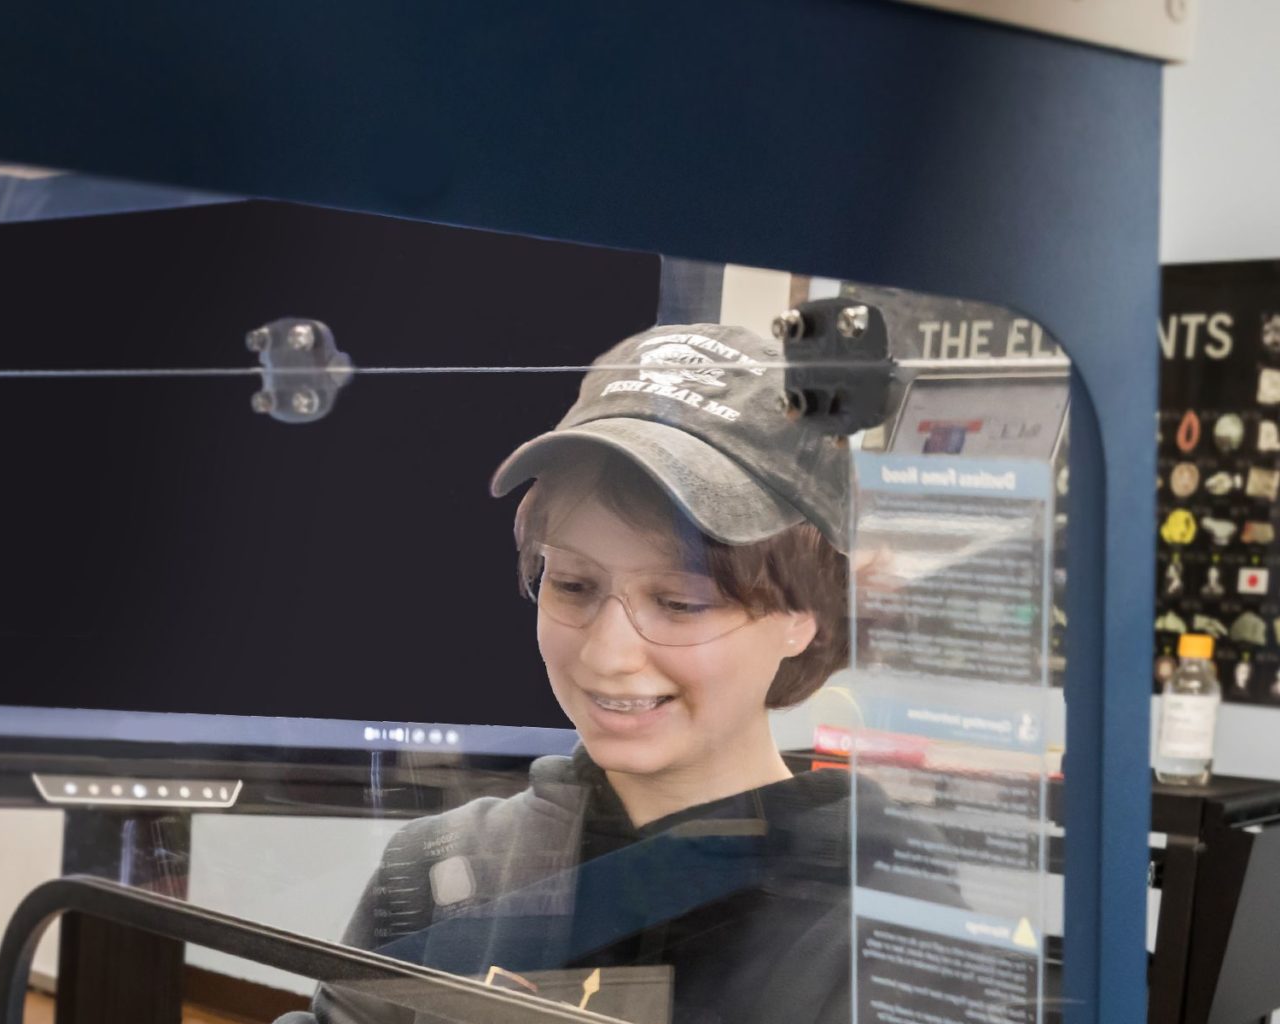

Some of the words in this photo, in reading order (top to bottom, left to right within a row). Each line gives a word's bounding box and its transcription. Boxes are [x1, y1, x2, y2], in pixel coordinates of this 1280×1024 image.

[686, 333, 741, 361] WANT
[919, 319, 993, 359] THE
[600, 380, 649, 397] FISH
[641, 382, 705, 408] FEAR
[702, 400, 741, 422] ME
